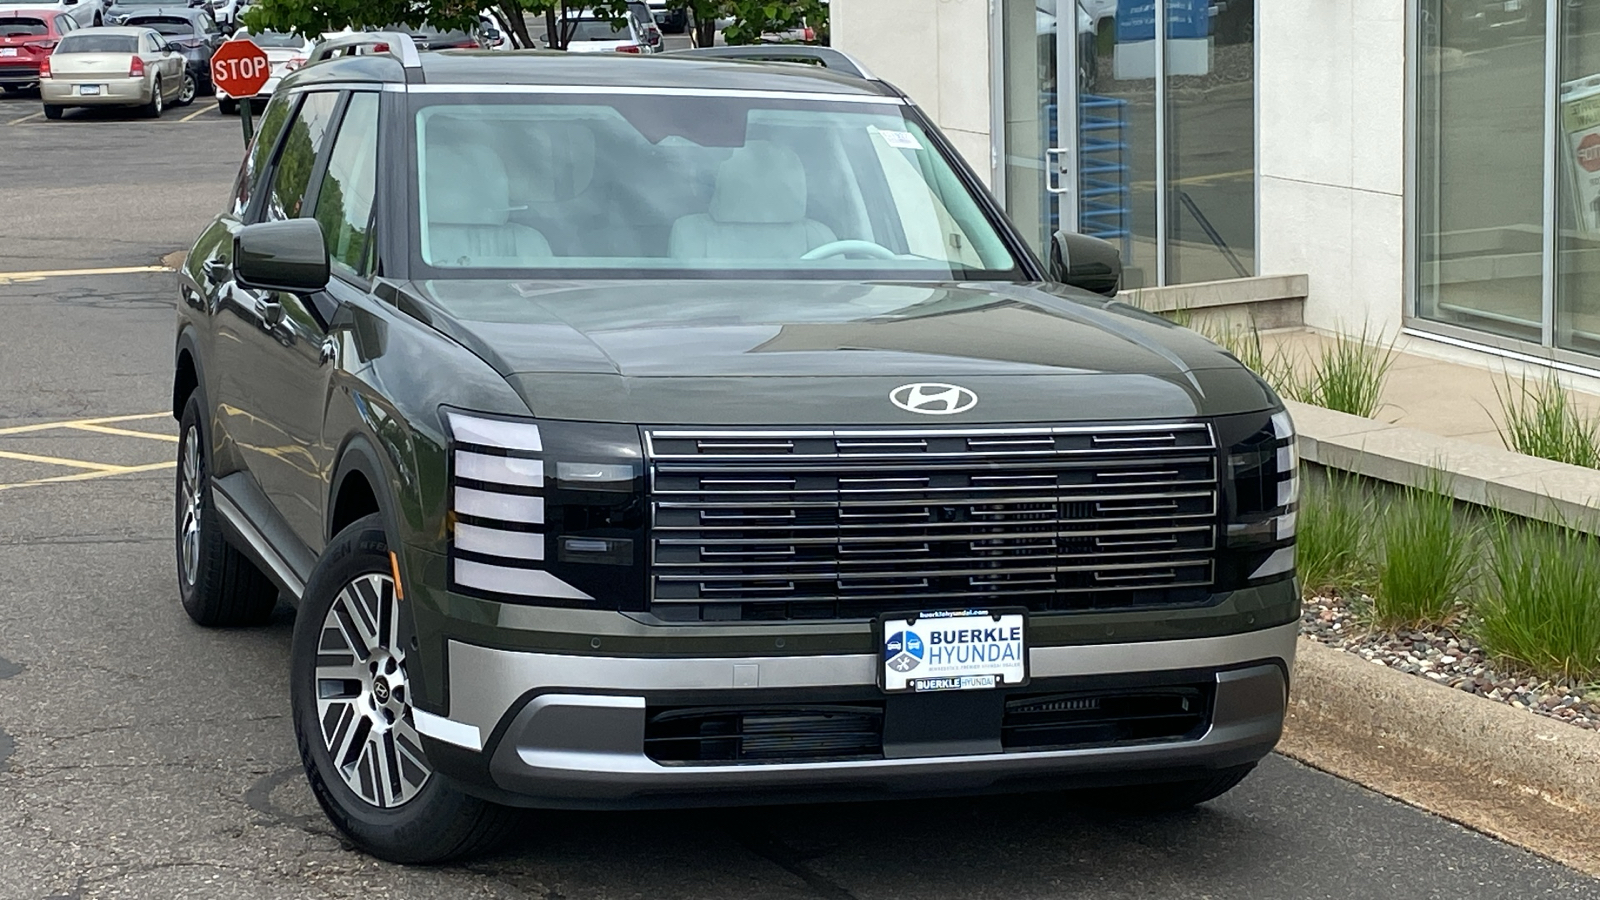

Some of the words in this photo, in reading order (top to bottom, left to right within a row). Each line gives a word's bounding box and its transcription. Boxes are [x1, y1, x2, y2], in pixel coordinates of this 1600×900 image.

[215, 56, 266, 81] STOP
[930, 626, 1021, 645] BUERKLE
[929, 642, 1021, 665] HYUNDAI
[917, 677, 960, 690] BUERKLE
[961, 676, 993, 687] HYUNDAI
